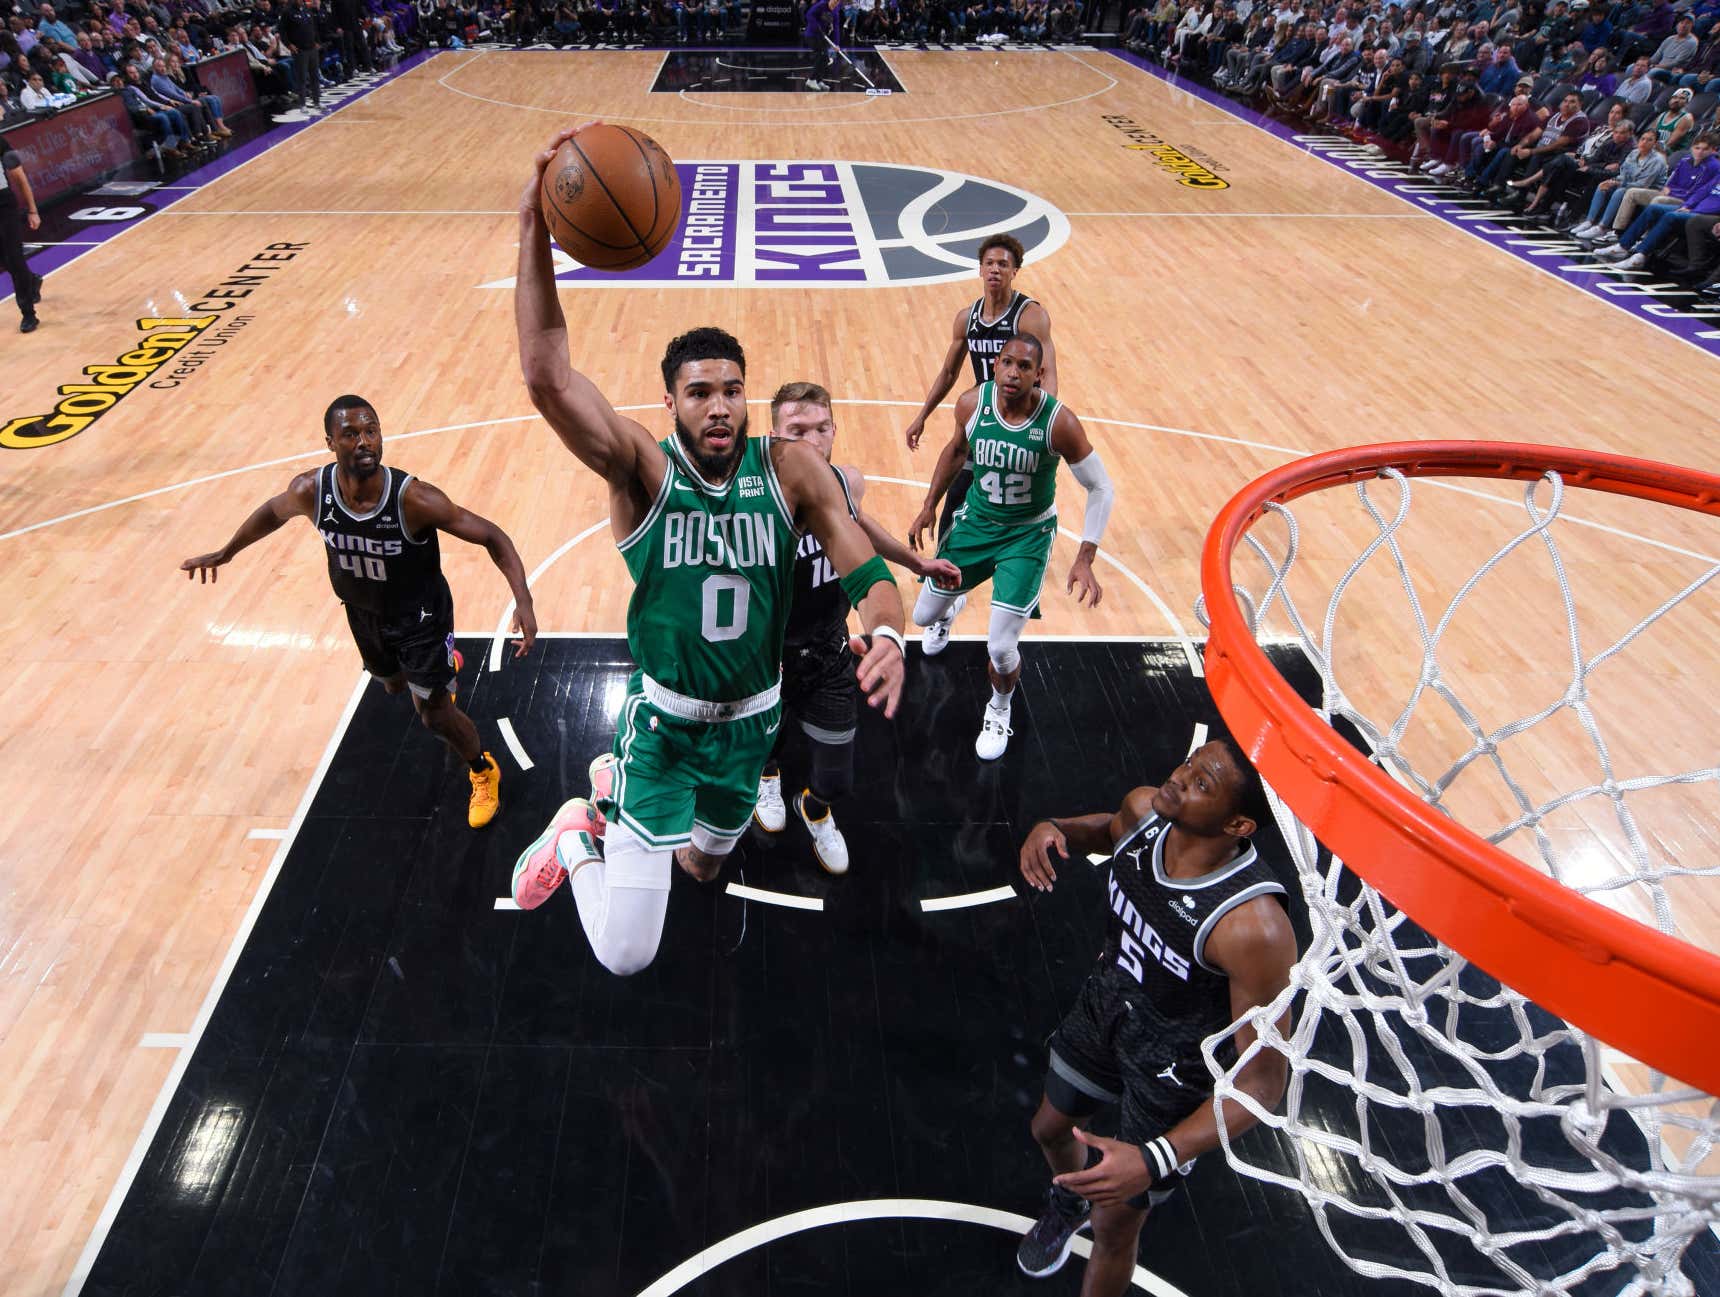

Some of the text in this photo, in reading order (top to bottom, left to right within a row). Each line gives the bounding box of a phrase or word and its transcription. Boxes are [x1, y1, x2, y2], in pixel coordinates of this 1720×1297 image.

[1101, 115, 1165, 144] CENTER
[677, 165, 729, 277] SACRAMENTO
[755, 163, 868, 282] KINGS
[190, 242, 310, 313] CENTER
[1394, 184, 1720, 340] CRAMENTO
[149, 314, 256, 390] Credit Union
[968, 339, 1007, 353] KING
[975, 439, 1040, 473] BOSTON
[738, 476, 764, 489] VISTA
[739, 487, 765, 498] PRINT
[979, 471, 1032, 504] 42
[325, 494, 332, 505] 6
[319, 528, 402, 556] KINGS
[663, 511, 776, 569] BOSTON
[338, 554, 388, 581] 40
[701, 574, 750, 643] 0
[1144, 826, 1159, 840] 6
[1168, 899, 1198, 927] dialpad
[1109, 879, 1191, 982] KINGS
[1117, 930, 1146, 984] 5
